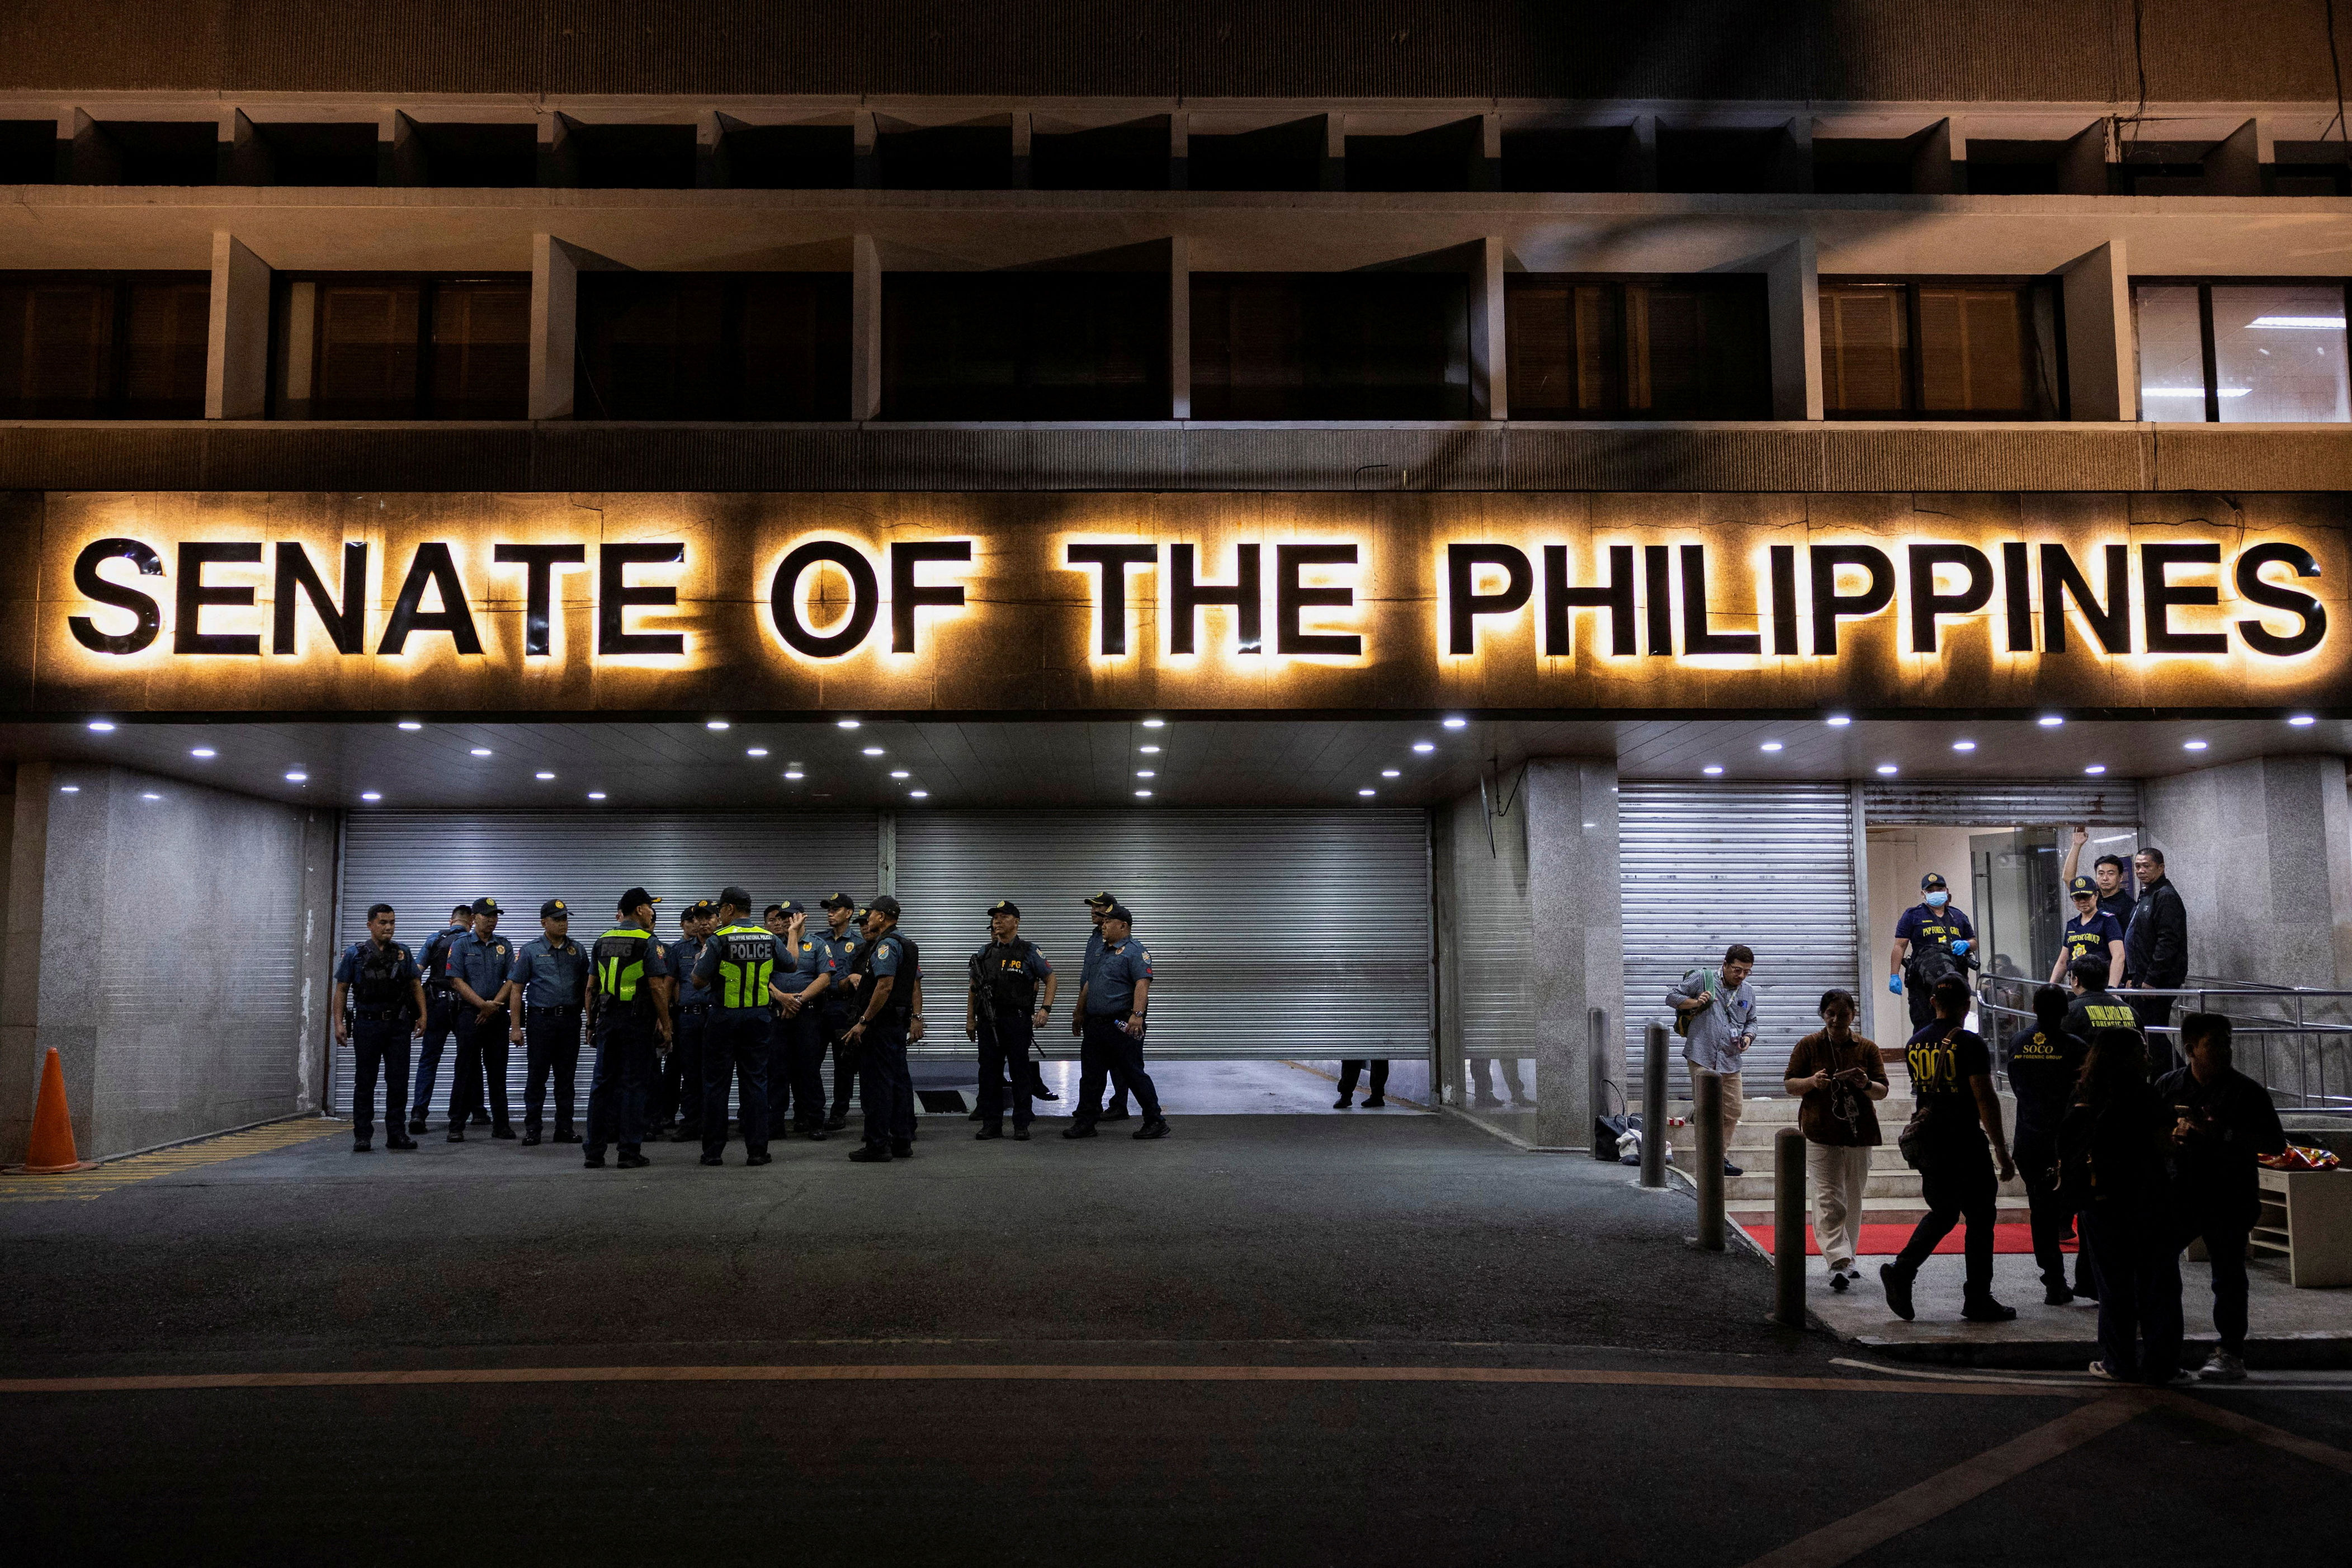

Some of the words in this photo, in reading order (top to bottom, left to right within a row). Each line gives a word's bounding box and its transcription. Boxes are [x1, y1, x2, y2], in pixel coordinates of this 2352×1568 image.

[68, 538, 686, 656] SENATE
[770, 541, 971, 658] OF
[1068, 543, 1361, 656] THE
[1447, 541, 2328, 657] PHILIPPINES
[1923, 927, 1931, 937] PNP
[2084, 933, 2100, 944] GROUP
[730, 943, 771, 958] POLICE
[2085, 1005, 2108, 1021] NATIONAL
[1909, 1042, 1957, 1051] POLIE
[2023, 1045, 2053, 1054] SOCO
